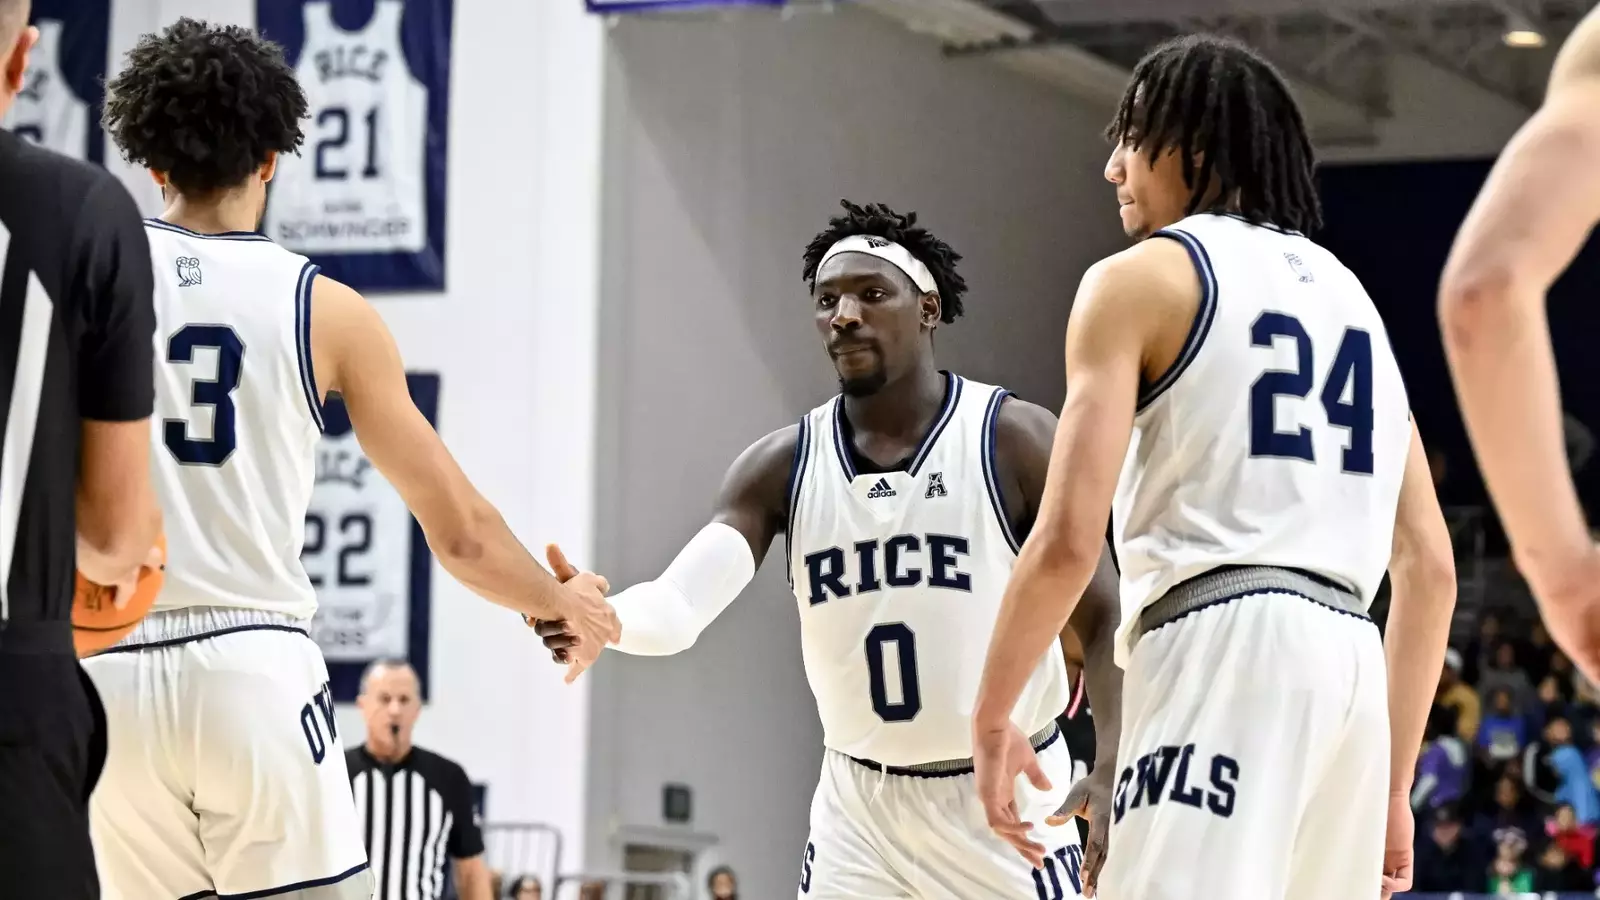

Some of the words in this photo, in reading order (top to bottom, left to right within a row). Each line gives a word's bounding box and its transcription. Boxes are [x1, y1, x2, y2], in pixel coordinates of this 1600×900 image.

[314, 46, 388, 82] RICE
[315, 107, 378, 178] 21
[162, 322, 247, 468] 3
[1248, 309, 1374, 477] 24
[315, 451, 372, 489] ICE
[867, 490, 897, 499] adidas
[302, 512, 374, 587] 22
[804, 533, 973, 608] RICE
[864, 621, 922, 724] 0
[1113, 743, 1240, 825] OWLS
